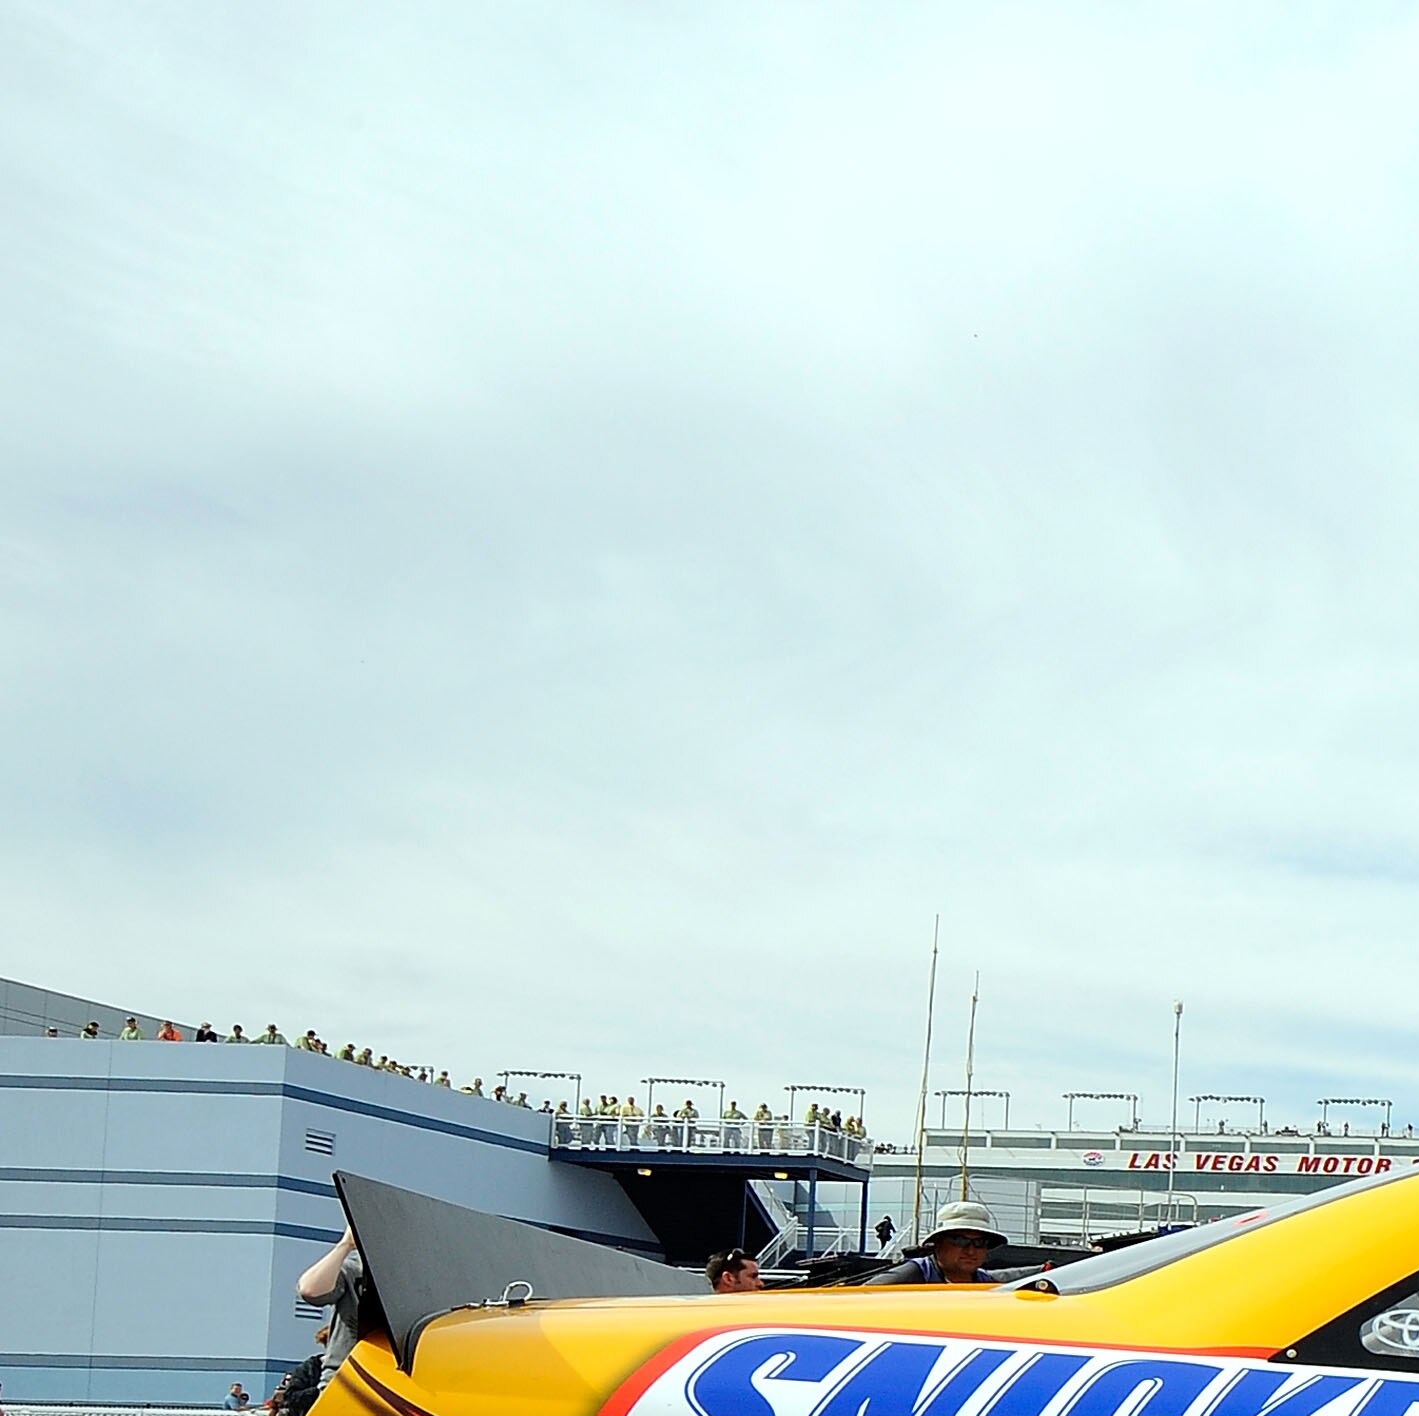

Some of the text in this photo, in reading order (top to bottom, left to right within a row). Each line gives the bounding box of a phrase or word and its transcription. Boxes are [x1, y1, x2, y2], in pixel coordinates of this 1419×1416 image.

[1128, 1152, 1178, 1170] LAS
[1194, 1153, 1279, 1172] VEGAS
[1296, 1155, 1392, 1175] MOTOR
